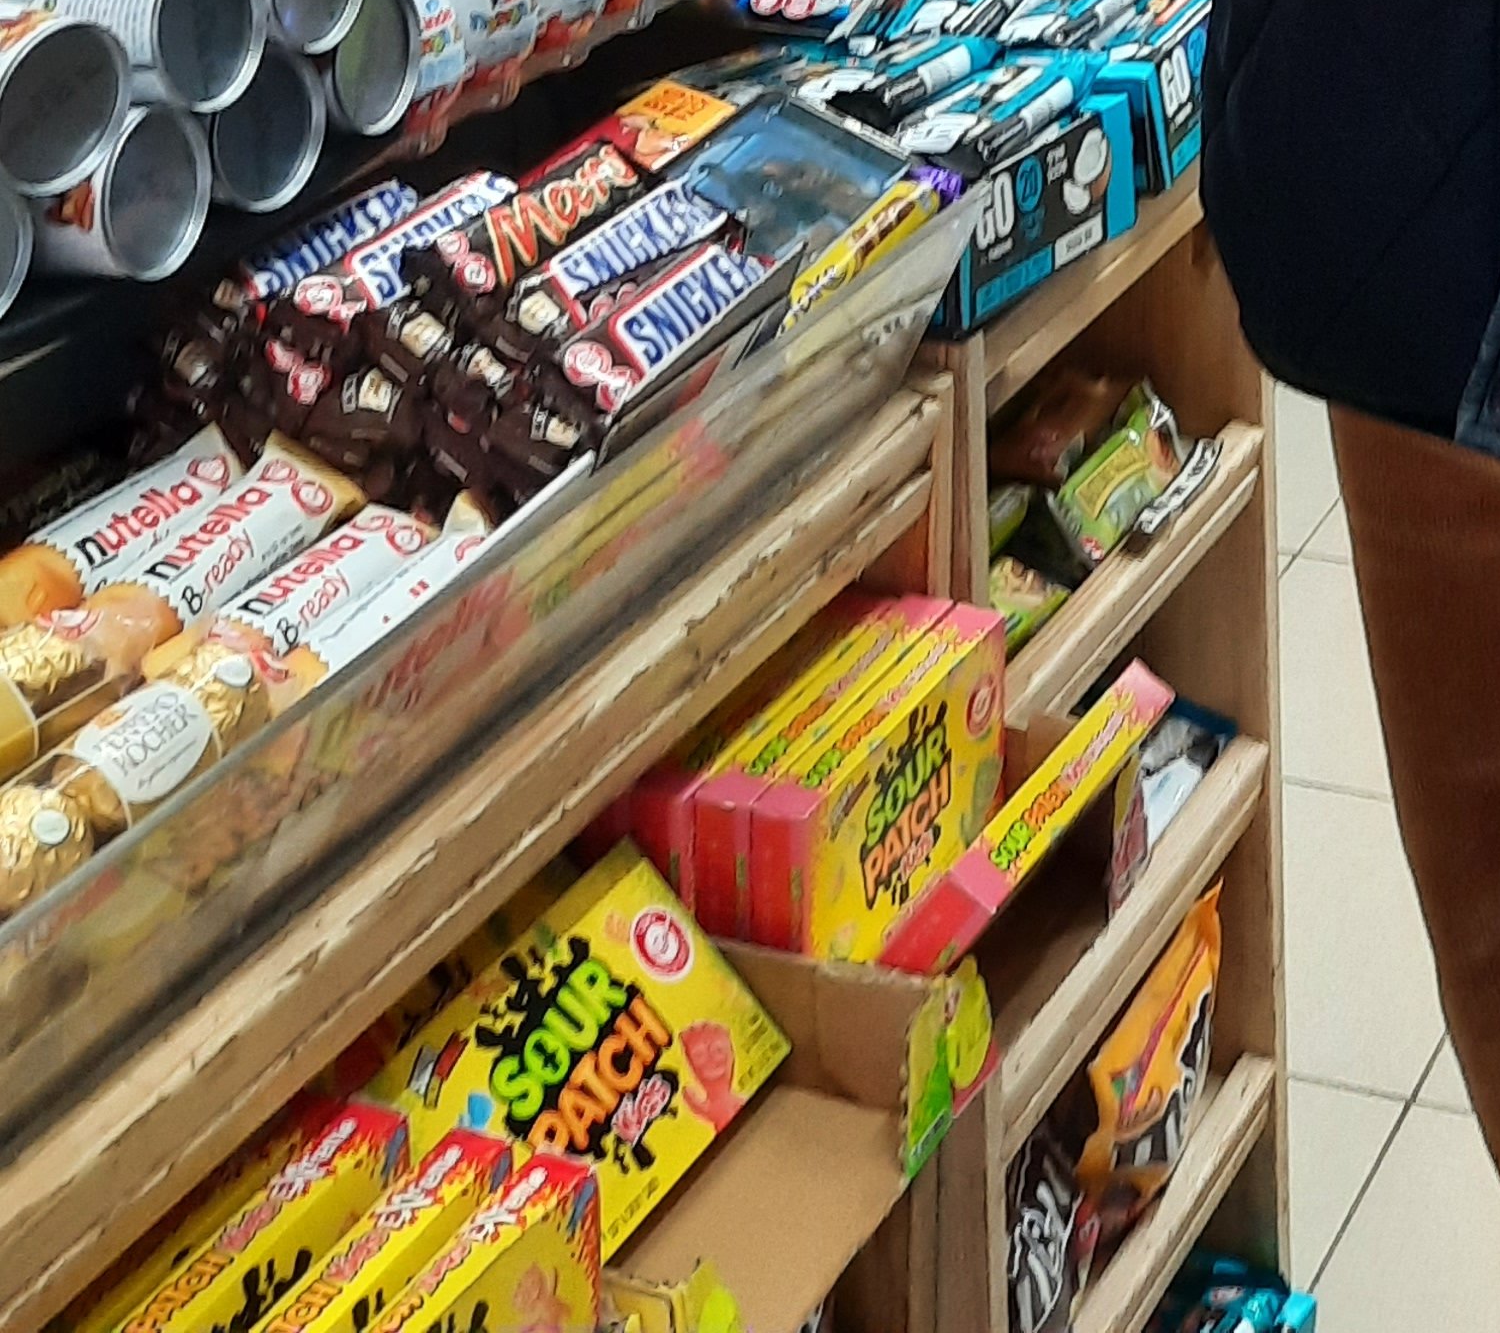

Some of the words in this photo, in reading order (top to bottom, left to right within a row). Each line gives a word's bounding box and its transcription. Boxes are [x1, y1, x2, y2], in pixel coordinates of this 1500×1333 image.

[74, 480, 203, 568] nutella
[144, 486, 272, 582] nutella
[180, 528, 257, 618] B-ready
[238, 533, 366, 616] nutella
[276, 570, 351, 654] B-ready
[864, 757, 953, 901] PATCH
[866, 721, 947, 848] SOUR
[491, 958, 628, 1122] SOUR
[527, 995, 672, 1152] PATCH
